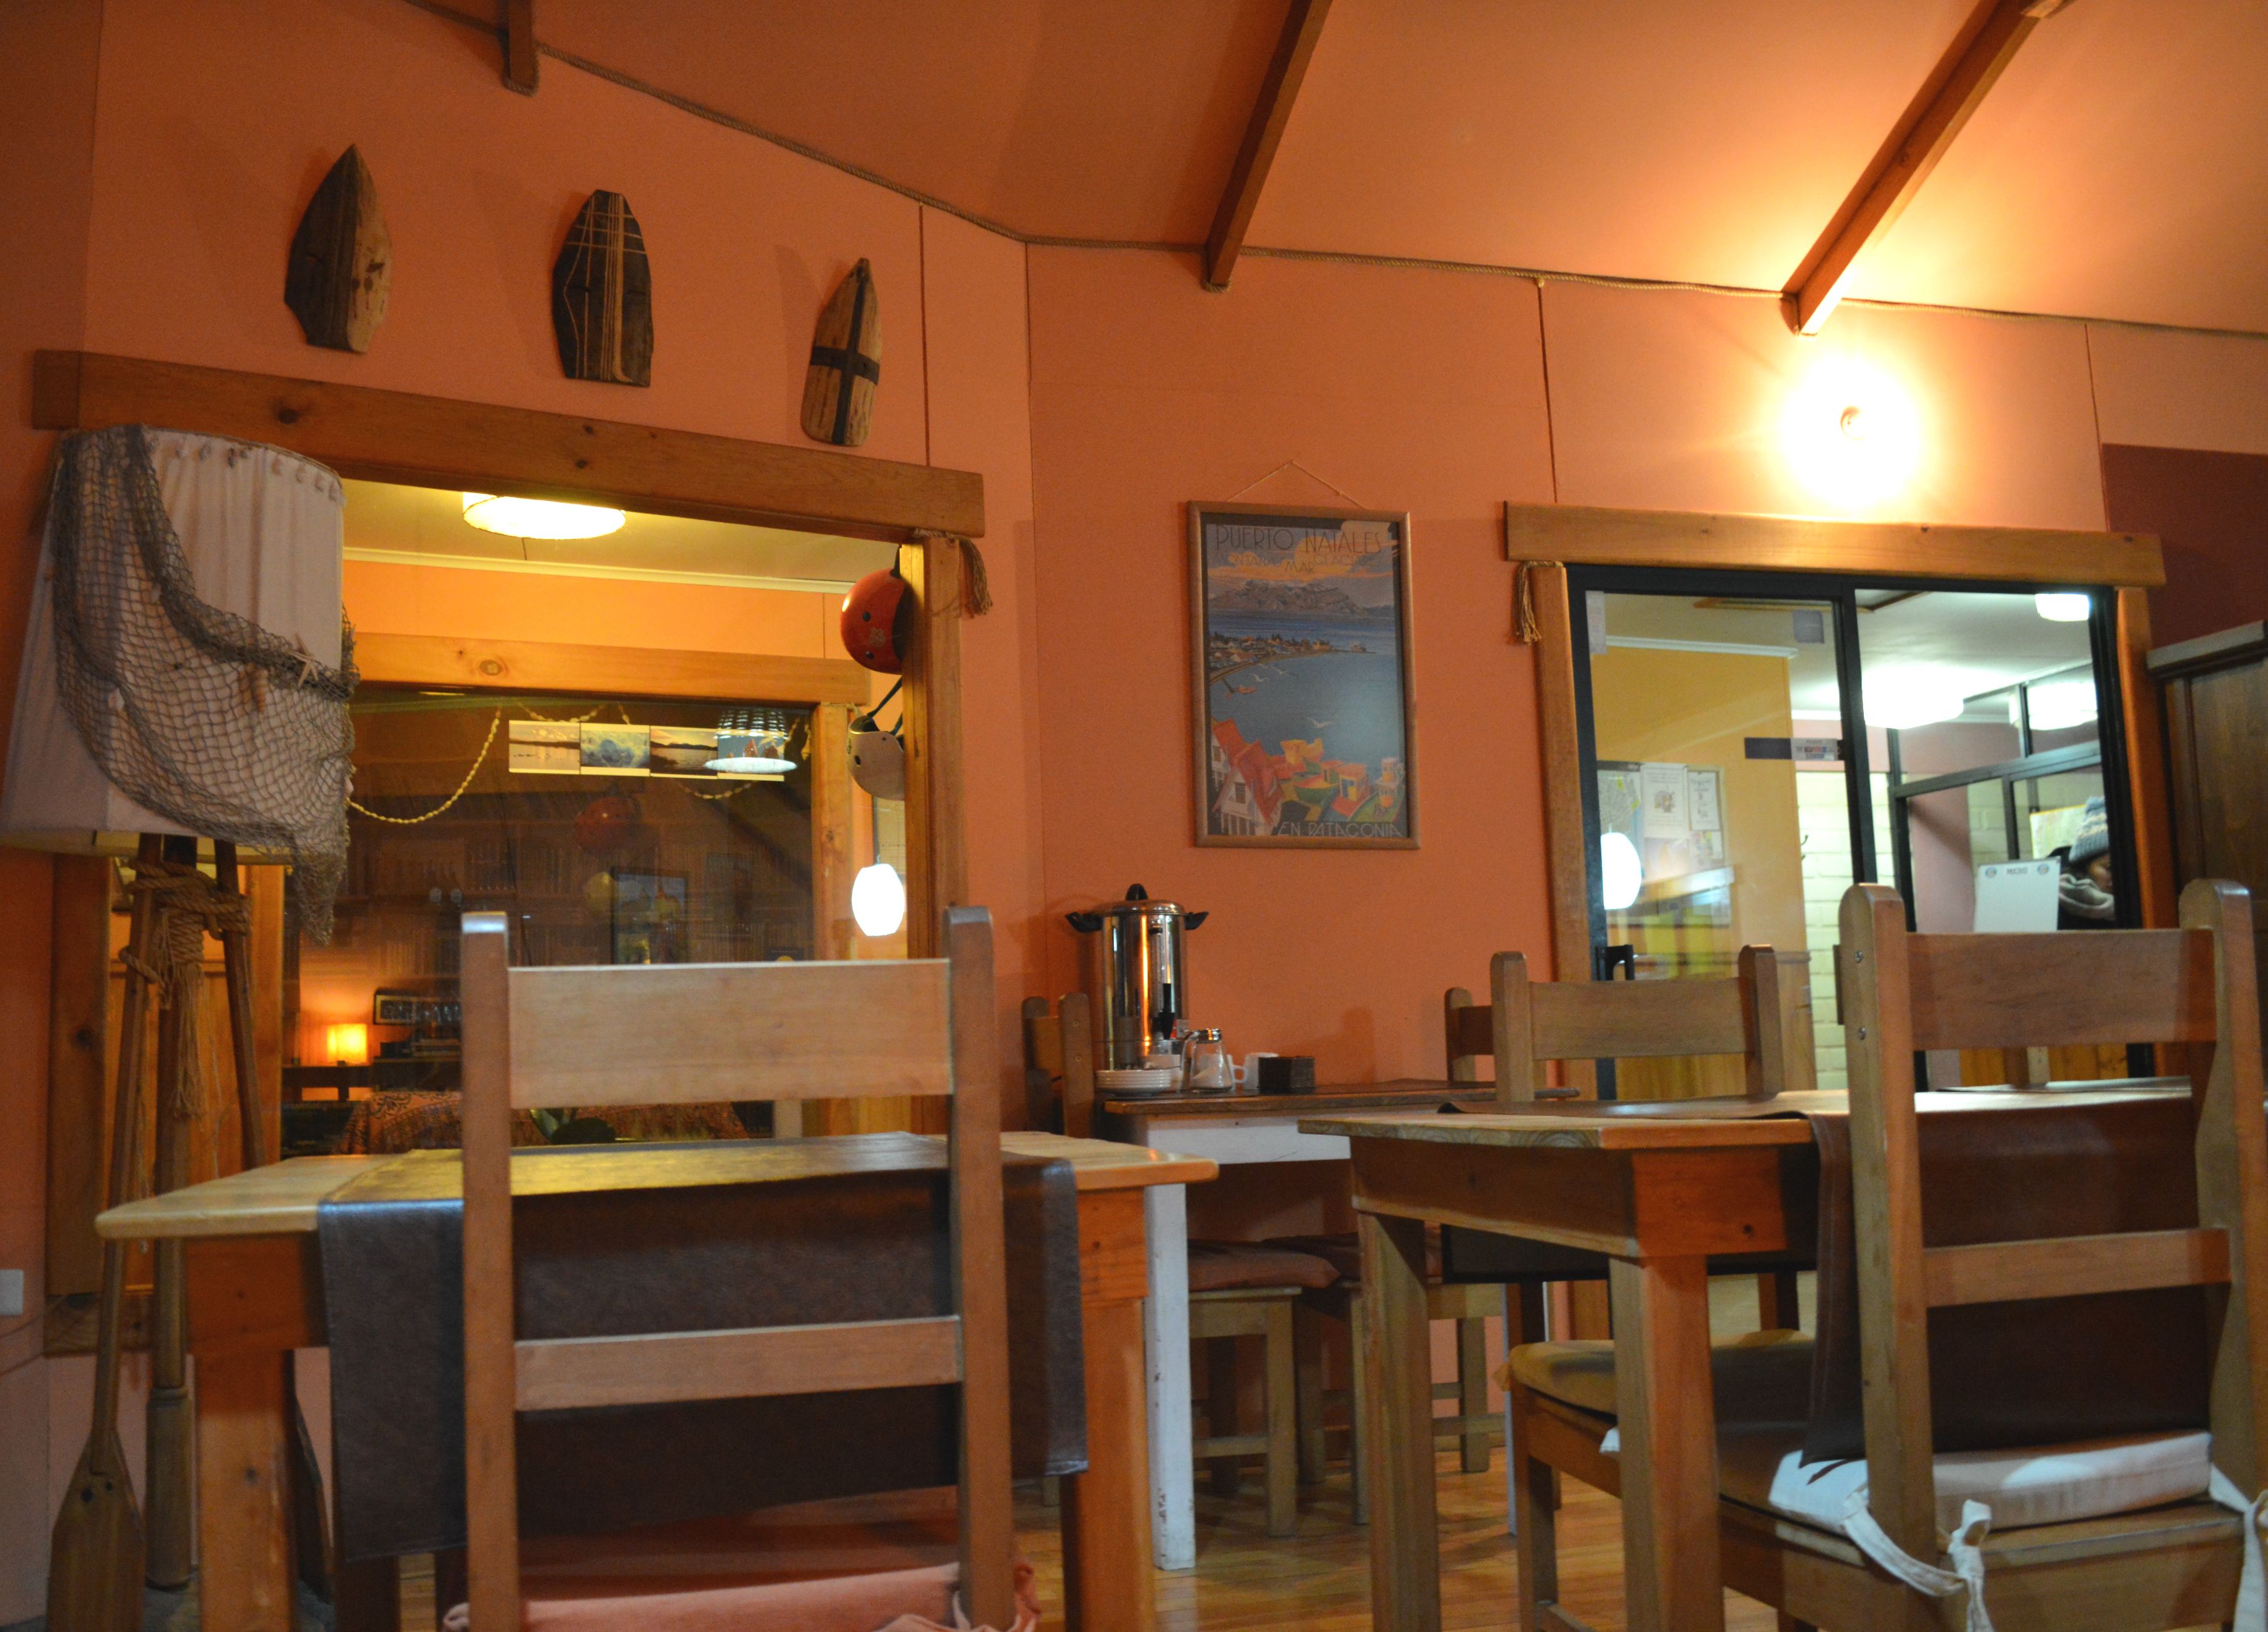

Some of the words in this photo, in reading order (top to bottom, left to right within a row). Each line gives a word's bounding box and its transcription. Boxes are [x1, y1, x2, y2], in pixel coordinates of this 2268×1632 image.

[1215, 524, 1294, 550] PUERTO
[1305, 528, 1381, 553] NATALES
[1285, 560, 1314, 573] MAR
[1277, 822, 1301, 836] EN
[1308, 822, 1406, 838] PATAGONIA
